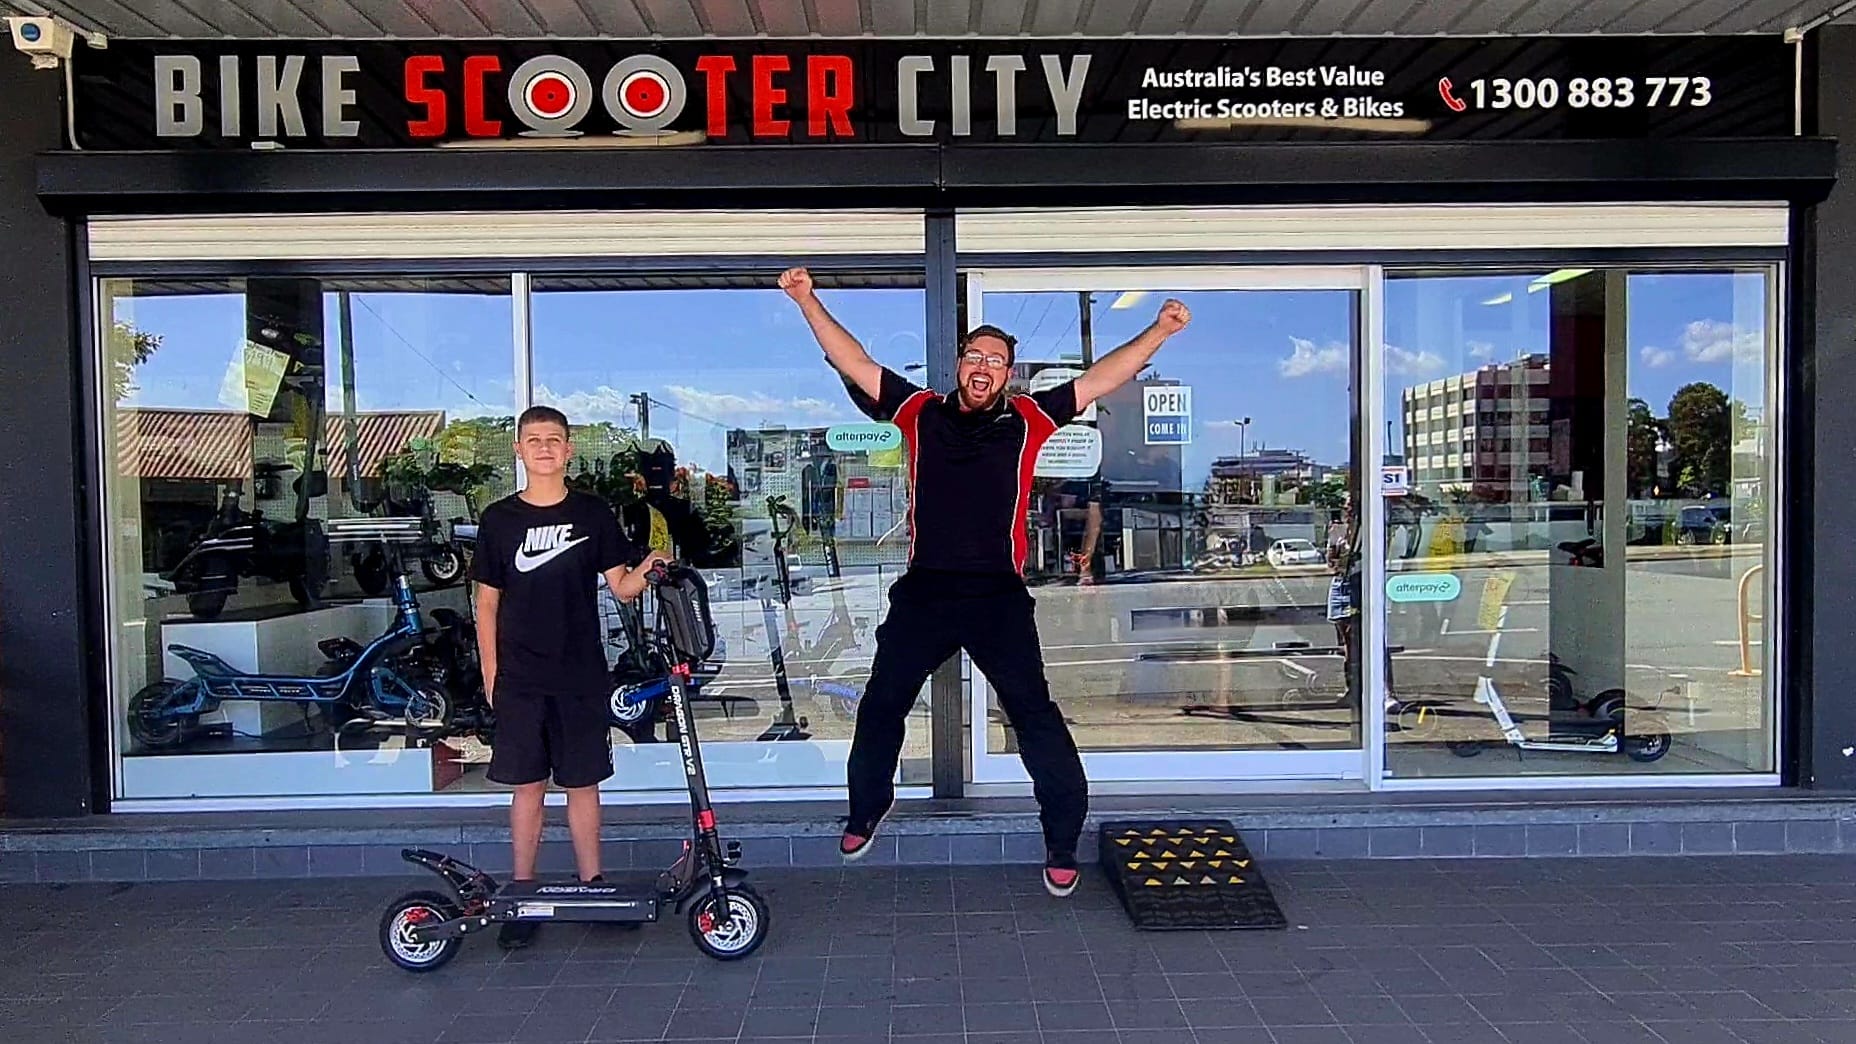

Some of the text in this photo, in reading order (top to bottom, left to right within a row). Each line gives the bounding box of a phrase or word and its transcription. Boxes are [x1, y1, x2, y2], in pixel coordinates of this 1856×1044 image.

[1142, 65, 1384, 88] Australia's Best Value
[154, 54, 1092, 137] BIKE SCOOTER CITY
[1470, 76, 1712, 109] 1300 883 773
[1128, 96, 1404, 119] Electric Scooters & Bikes
[1147, 393, 1187, 412] OPEN
[835, 431, 880, 442] afterpay
[1149, 423, 1188, 436] COME IN
[1383, 473, 1400, 484] S1
[523, 523, 574, 553] NIKE
[1396, 582, 1438, 594] afterpay
[671, 685, 689, 734] DRAGON
[685, 758, 696, 775] V2
